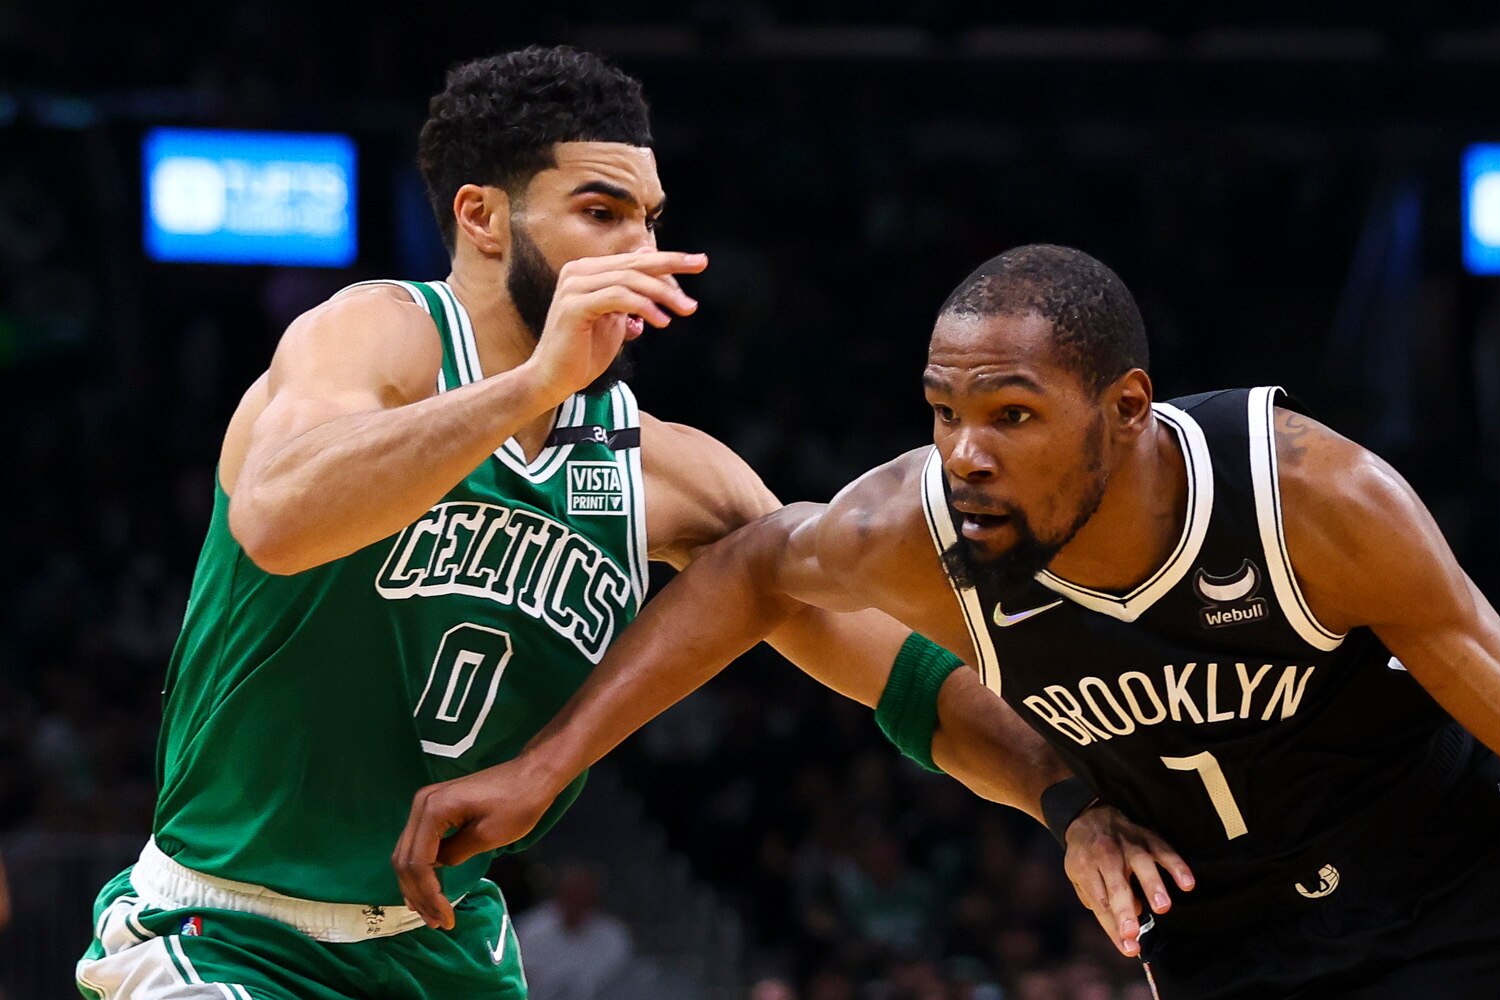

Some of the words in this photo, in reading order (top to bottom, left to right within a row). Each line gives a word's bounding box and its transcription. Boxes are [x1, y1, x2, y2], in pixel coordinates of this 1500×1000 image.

[572, 467, 622, 491] VISTA
[572, 496, 605, 510] PRINT
[375, 500, 632, 665] CELTICS
[1204, 602, 1264, 627] Webull
[411, 621, 515, 760] 0
[1021, 662, 1316, 747] BROOKLYN
[1159, 750, 1249, 841] 7
